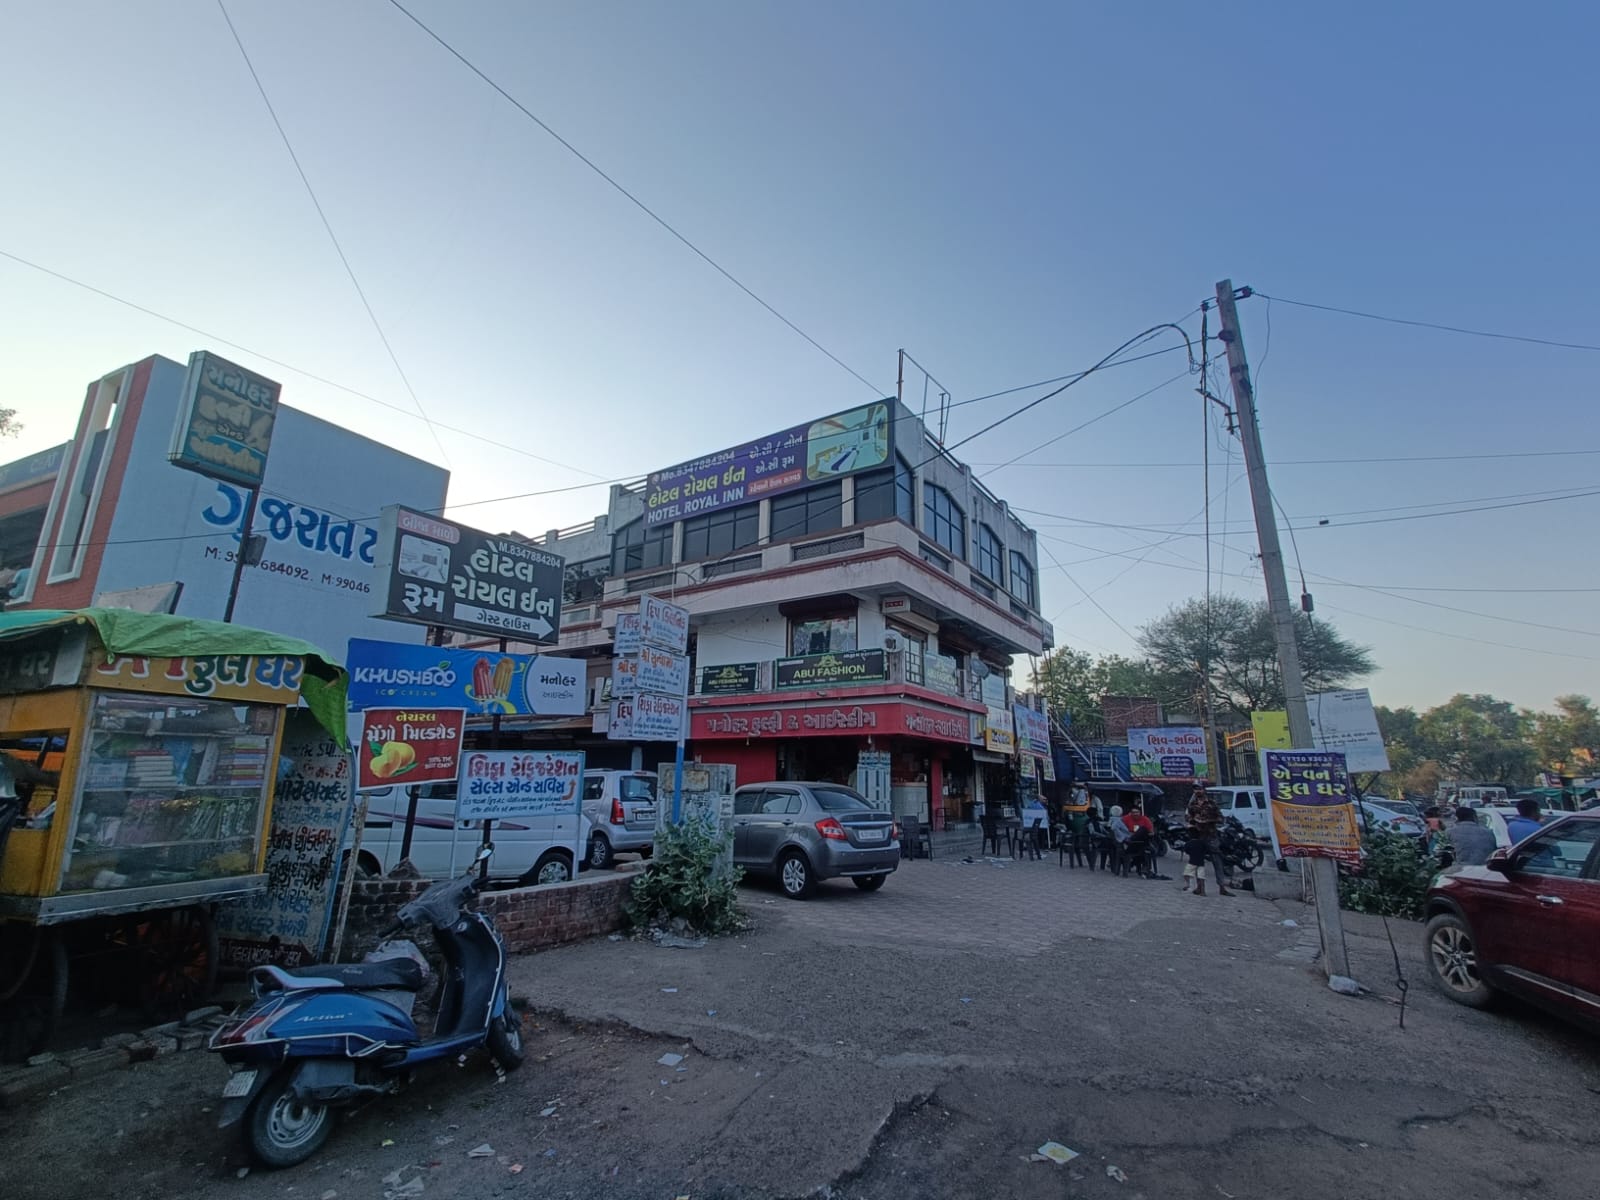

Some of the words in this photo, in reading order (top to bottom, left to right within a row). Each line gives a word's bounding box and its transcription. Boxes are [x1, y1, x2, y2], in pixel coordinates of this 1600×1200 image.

[648, 486, 680, 508] હોટલ
[684, 474, 718, 497] રોયલ
[722, 465, 746, 486] ઈન
[647, 504, 682, 524] HOTEL
[684, 493, 720, 513] ROYAL
[723, 486, 745, 504] INN
[470, 540, 534, 583] હોટલ
[452, 565, 517, 609] રોયલ
[521, 588, 555, 617] ઈન
[402, 582, 446, 614] રૂમ
[477, 609, 501, 626] ગેસ્ટ
[255, 655, 304, 689] ઘર
[355, 666, 457, 688] KHUSHBOO
[541, 672, 577, 686] મનોહર
[794, 669, 816, 679] ABU
[817, 664, 866, 677] FASHION
[396, 711, 437, 722] નેચરલ
[468, 754, 506, 782] શિફા
[1272, 765, 1331, 780] એ-વન
[471, 778, 503, 795] સેલ્સ
[506, 778, 531, 794] એન્ડ
[1277, 782, 1311, 800] ફુલ
[1316, 783, 1347, 796] ઘર
